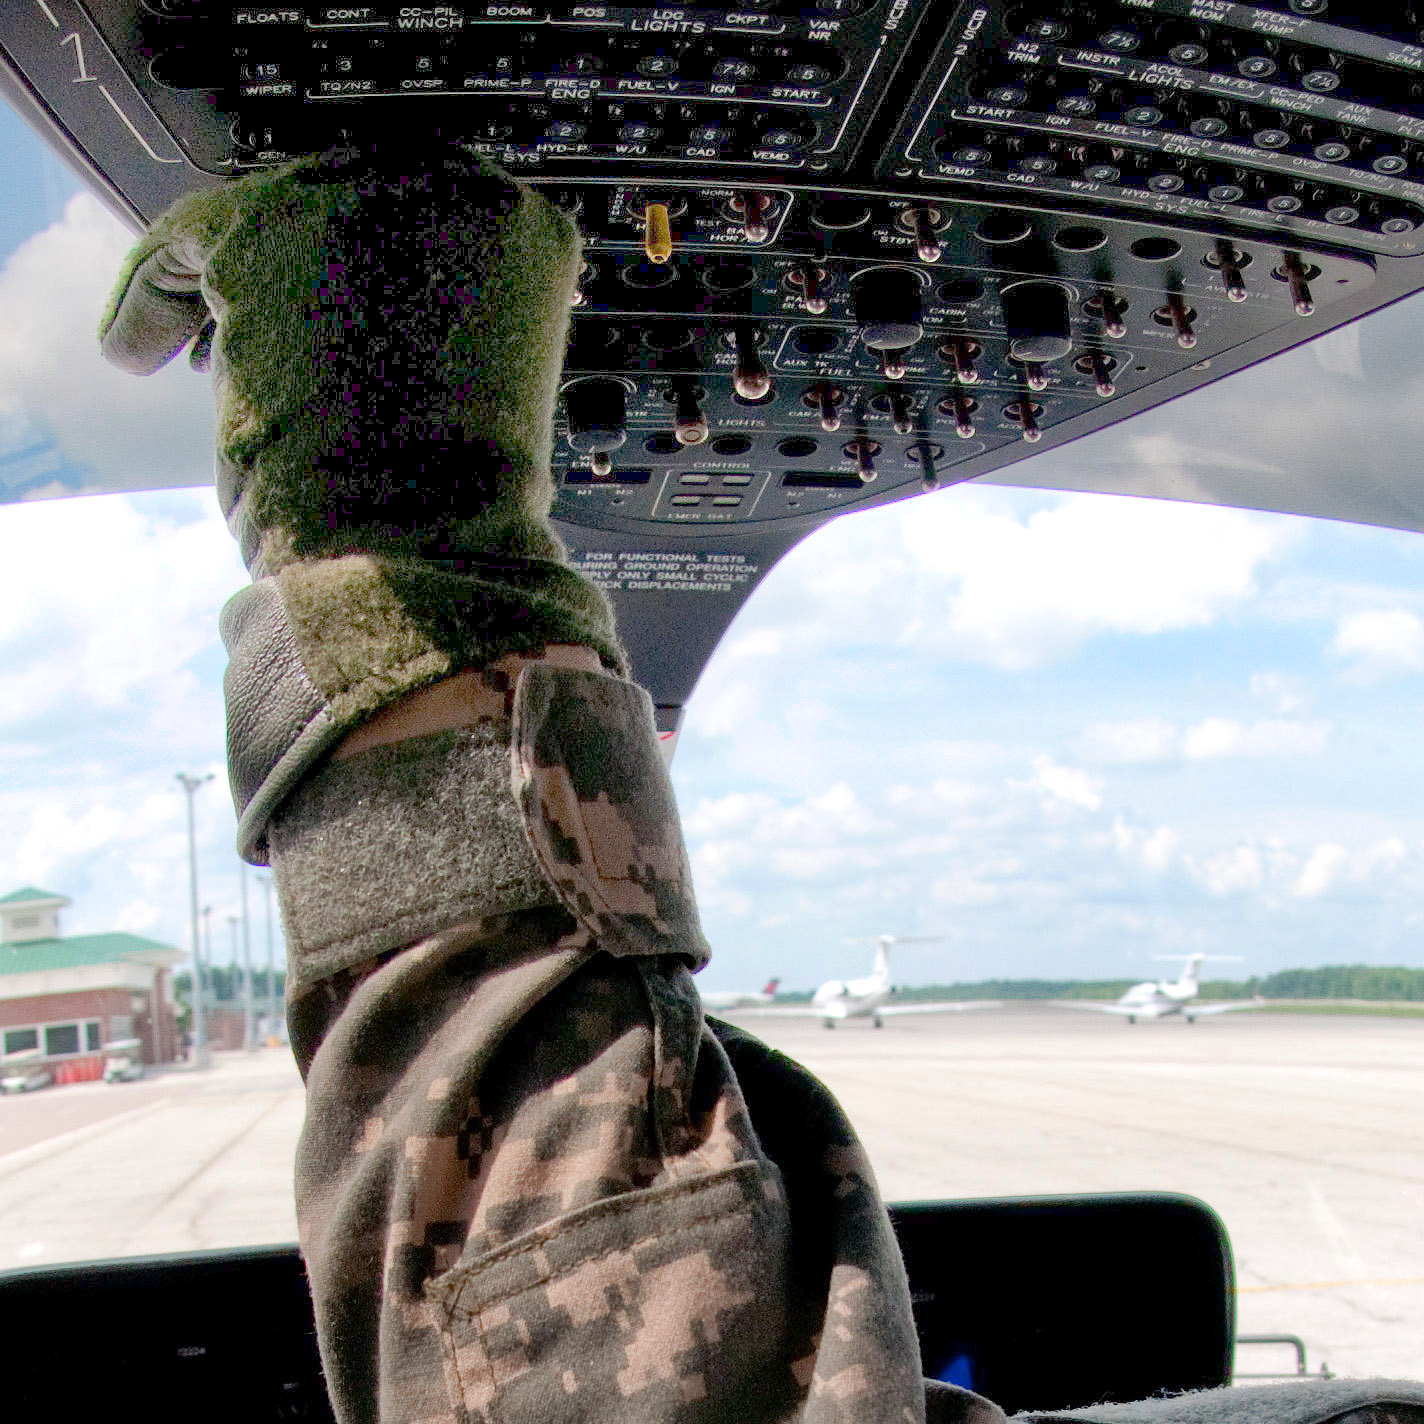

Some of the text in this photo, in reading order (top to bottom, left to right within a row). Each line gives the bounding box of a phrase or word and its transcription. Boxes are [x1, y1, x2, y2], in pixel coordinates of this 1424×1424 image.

[326, 8, 370, 19] CONT
[399, 7, 459, 17] CC-PIL
[486, 7, 534, 17] BOOM
[572, 7, 607, 18] POS
[652, 9, 685, 20] LDG
[1189, 9, 1225, 22] MOM
[236, 12, 300, 24] FLOATS
[397, 18, 464, 29] WINCH
[725, 14, 769, 25] CKPT
[631, 19, 706, 34] LIGHTS
[807, 18, 841, 31] VAR
[1252, 21, 1294, 35] PUMP
[808, 31, 832, 40] NR
[953, 9, 987, 55] BUS 2
[1015, 42, 1040, 54] N2
[1006, 51, 1041, 64] TRIM
[1076, 51, 1121, 66] INSTR
[256, 64, 278, 76] 15
[340, 60, 352, 71] 3
[650, 60, 664, 71] 2
[801, 69, 815, 80] 5
[1128, 70, 1195, 90] LIGHTS
[321, 81, 373, 91] TQ/N2
[401, 79, 444, 89] OVSP
[463, 78, 533, 89] PRIME-P
[544, 78, 601, 89] FIRE-D
[617, 80, 680, 92] FUEL-V
[709, 83, 736, 94] IGN
[245, 84, 293, 95] WIPER
[551, 88, 592, 100] ENG
[770, 88, 821, 99] START
[1270, 97, 1312, 112] WINCH
[1343, 103, 1374, 115] AUX
[966, 105, 1015, 118] START
[1137, 111, 1150, 120] 2
[1044, 115, 1072, 126] IGN
[1336, 111, 1369, 124] TANK
[560, 126, 573, 137] 2
[632, 127, 647, 138] 2
[703, 129, 716, 140] 5
[1094, 122, 1153, 138] FUEL-V
[775, 134, 787, 145] 5
[1162, 133, 1212, 149] FIRE-D
[615, 144, 647, 154] W/U
[685, 148, 716, 158] CAD
[1162, 143, 1200, 157] ENG
[1219, 142, 1280, 160] PRIME-P
[503, 152, 541, 163] SYS
[752, 151, 790, 161] VEMD
[1292, 158, 1327, 170] OVSP
[937, 165, 976, 176] VEMD
[1006, 173, 1036, 184] CAD
[1070, 181, 1100, 192] W/U
[701, 189, 734, 197] NORM
[1152, 201, 1188, 214] SYS
[782, 359, 809, 367] AUX
[819, 367, 853, 375] FUEL
[585, 552, 746, 563] FOR FUNCTIONAL TESTS
[624, 561, 681, 571] GROUND
[686, 563, 759, 573] OPERATION
[617, 571, 652, 580] ONLY
[656, 571, 697, 581] SMALL
[703, 573, 749, 583] CYCLIC
[627, 580, 732, 592] DISPLACEMENTS
